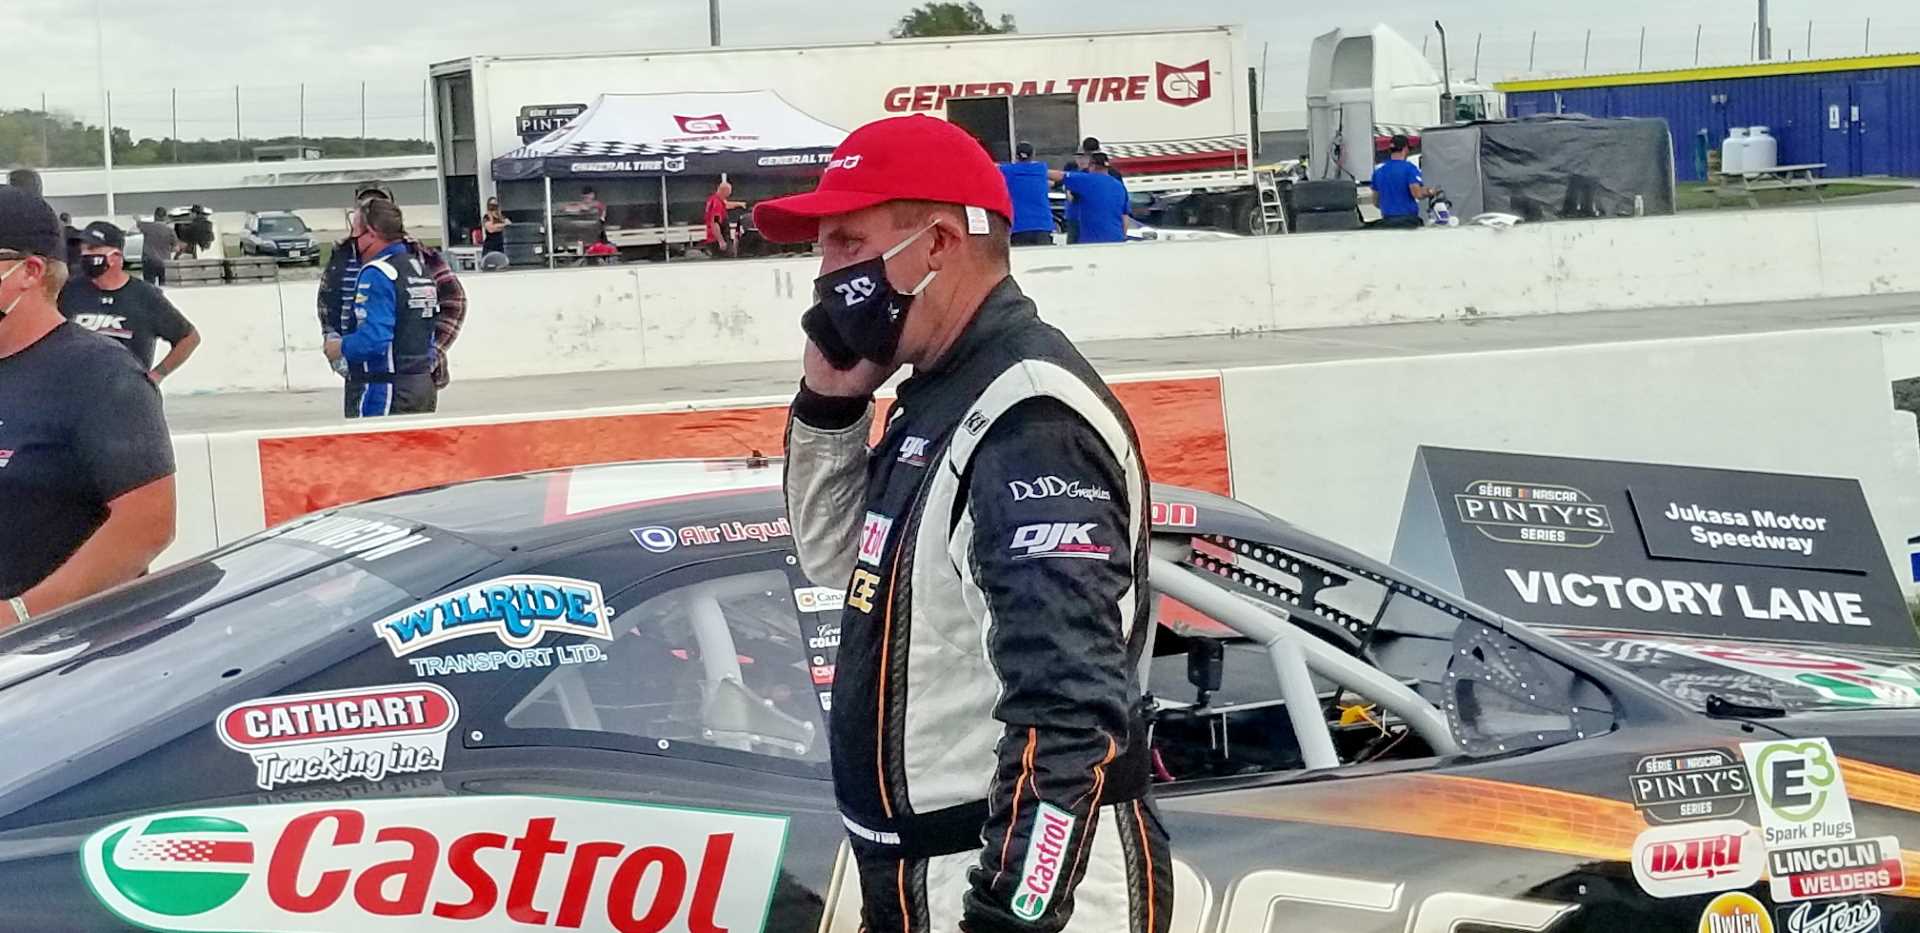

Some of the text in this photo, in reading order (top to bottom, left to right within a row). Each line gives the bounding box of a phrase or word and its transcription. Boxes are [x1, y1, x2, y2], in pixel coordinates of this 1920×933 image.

[1065, 76, 1149, 103] TIRE
[758, 154, 815, 166] GENERAL
[1008, 475, 1067, 501] DJD
[1533, 488, 1578, 502] NASCAR
[1465, 499, 1605, 528] PINTY'S
[1665, 502, 1827, 531] Jukasa Motor
[678, 525, 720, 547] Air
[1009, 522, 1099, 554] DJK
[1520, 527, 1566, 542] SERIES
[1690, 525, 1813, 555] Speedway
[385, 582, 599, 644] WILRIDE
[1504, 569, 1872, 627] VICTORY LANE
[408, 643, 608, 677] TRANSPORT LTD.
[243, 694, 427, 738] CATHCART
[255, 745, 386, 785] Trucking
[1637, 769, 1745, 800] PINTY'S
[1680, 801, 1713, 816] SERIES
[1765, 821, 1853, 843] Spark Plugs
[1026, 812, 1069, 895] Castrol
[1651, 834, 1743, 873] DART
[1773, 843, 1877, 875] LINCOLN
[266, 808, 735, 933] Castrol
[1799, 869, 1891, 895] WELDERS
